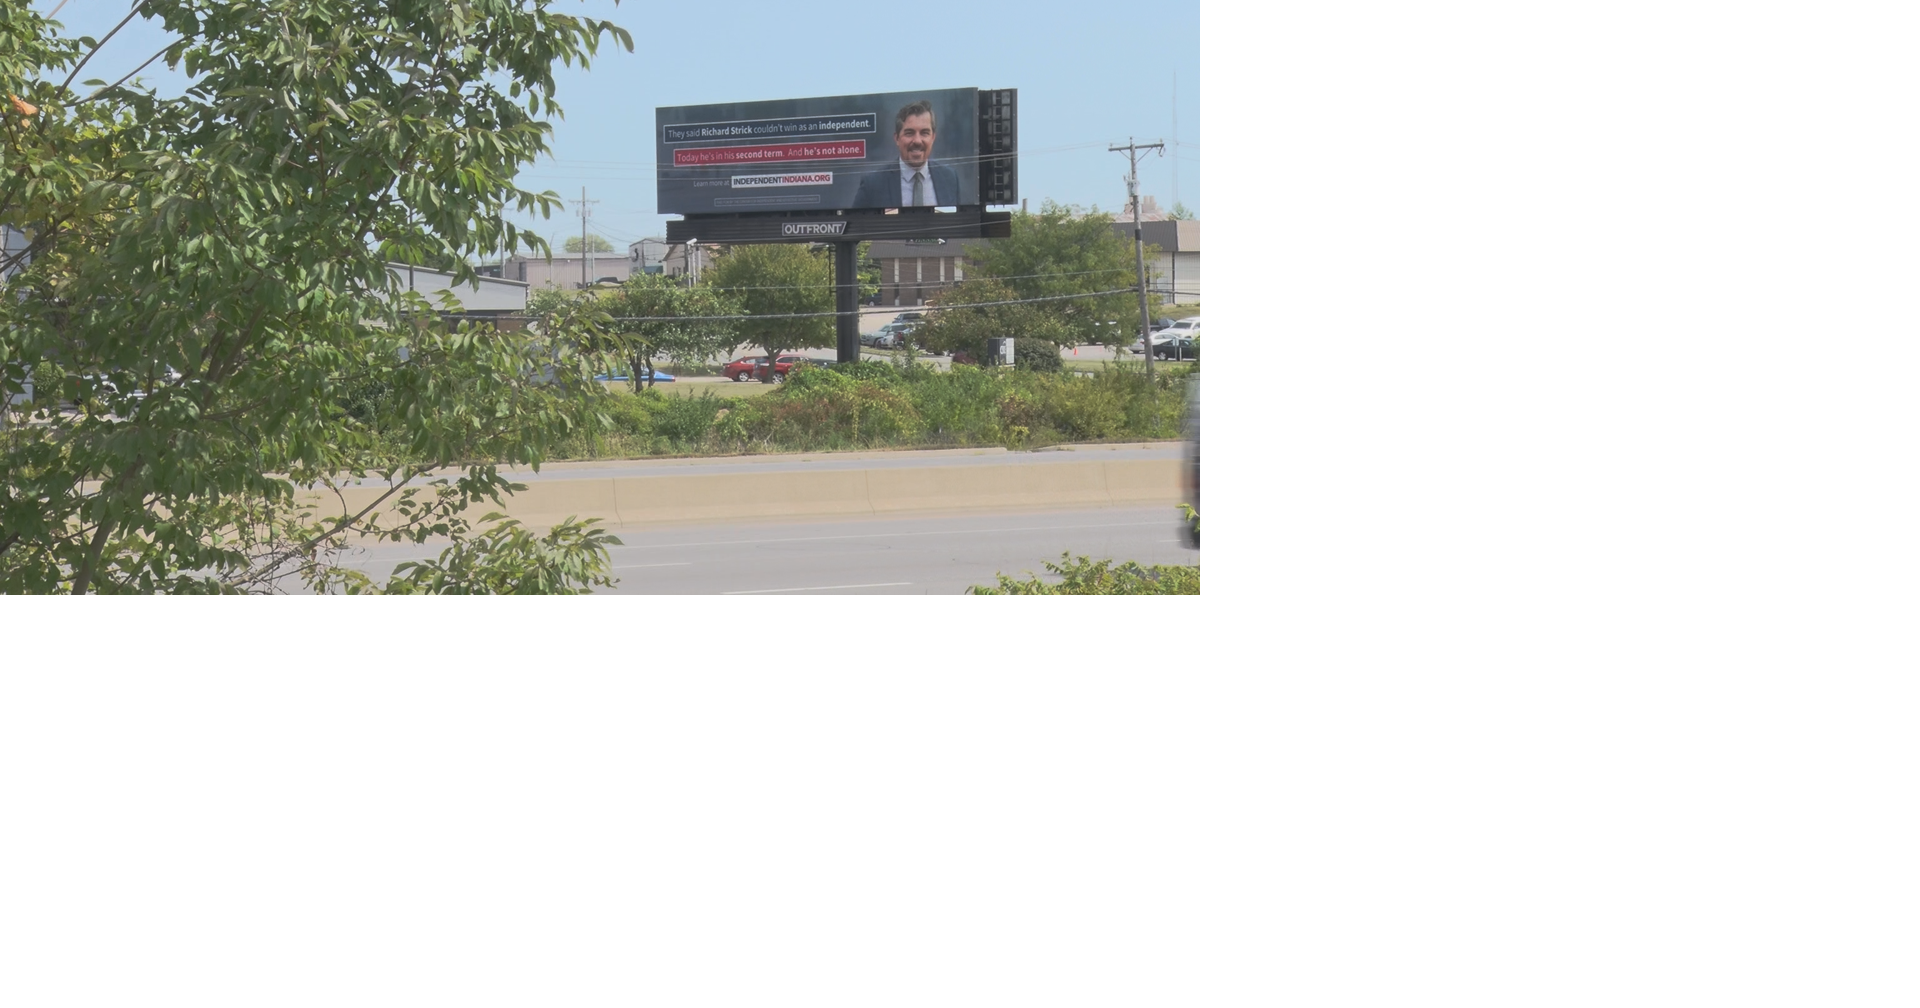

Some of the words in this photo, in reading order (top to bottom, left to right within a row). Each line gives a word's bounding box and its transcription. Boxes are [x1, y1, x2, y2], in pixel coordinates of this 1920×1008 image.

[668, 130, 685, 139] They
[686, 129, 700, 137] said
[701, 126, 730, 136] Richard
[731, 126, 752, 134] Strick
[754, 124, 783, 133] couldn't
[784, 122, 797, 131] win
[819, 120, 871, 130] independent.
[677, 153, 699, 162] Today
[700, 152, 714, 160] he's
[716, 152, 722, 160] in
[724, 151, 734, 160] his
[736, 150, 762, 159] second
[788, 148, 802, 156] And
[804, 147, 820, 156] he's
[822, 147, 836, 155] not
[837, 146, 862, 154] alone.
[734, 174, 830, 185] INDEPENDENTINDIANA.ORG
[784, 224, 842, 234] OUTFRONT
